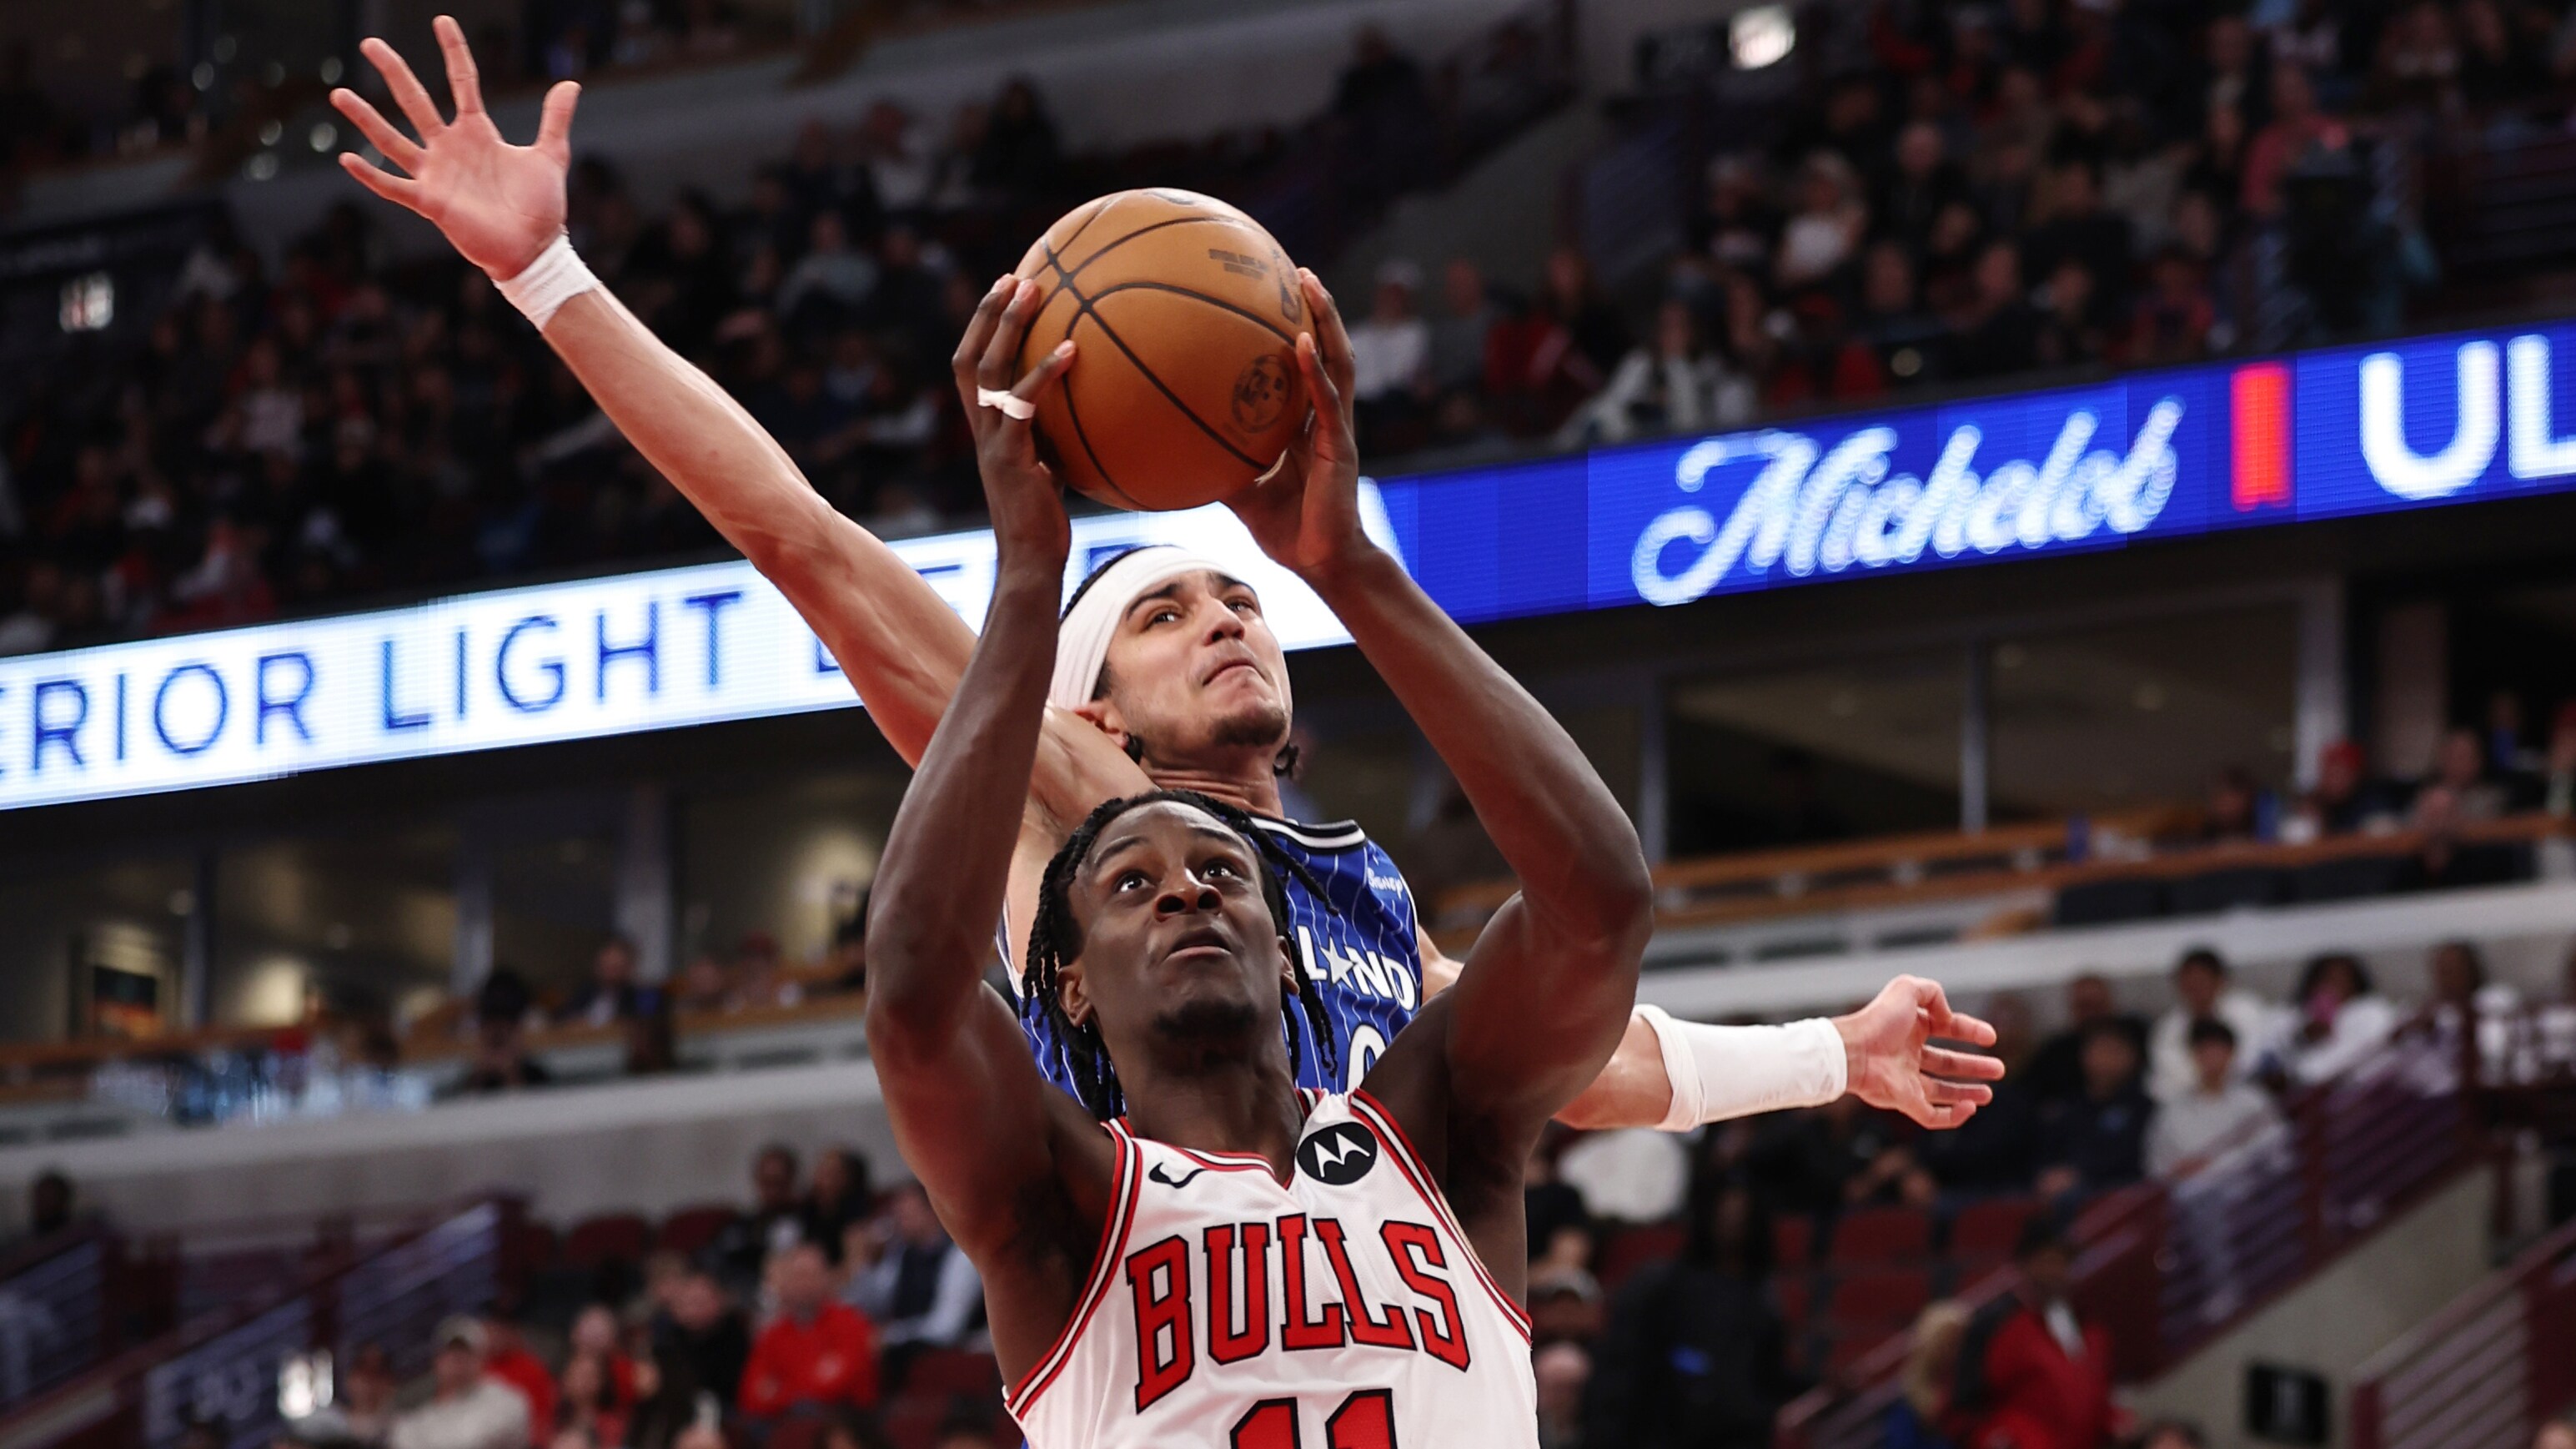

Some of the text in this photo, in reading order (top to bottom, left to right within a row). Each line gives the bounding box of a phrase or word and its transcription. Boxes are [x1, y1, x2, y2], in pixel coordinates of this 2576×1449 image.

[1631, 334, 2576, 606] Michelob UL
[0, 652, 316, 774] RIOR
[383, 591, 742, 729] LIGHT
[1125, 1212, 1471, 1414] BULLS
